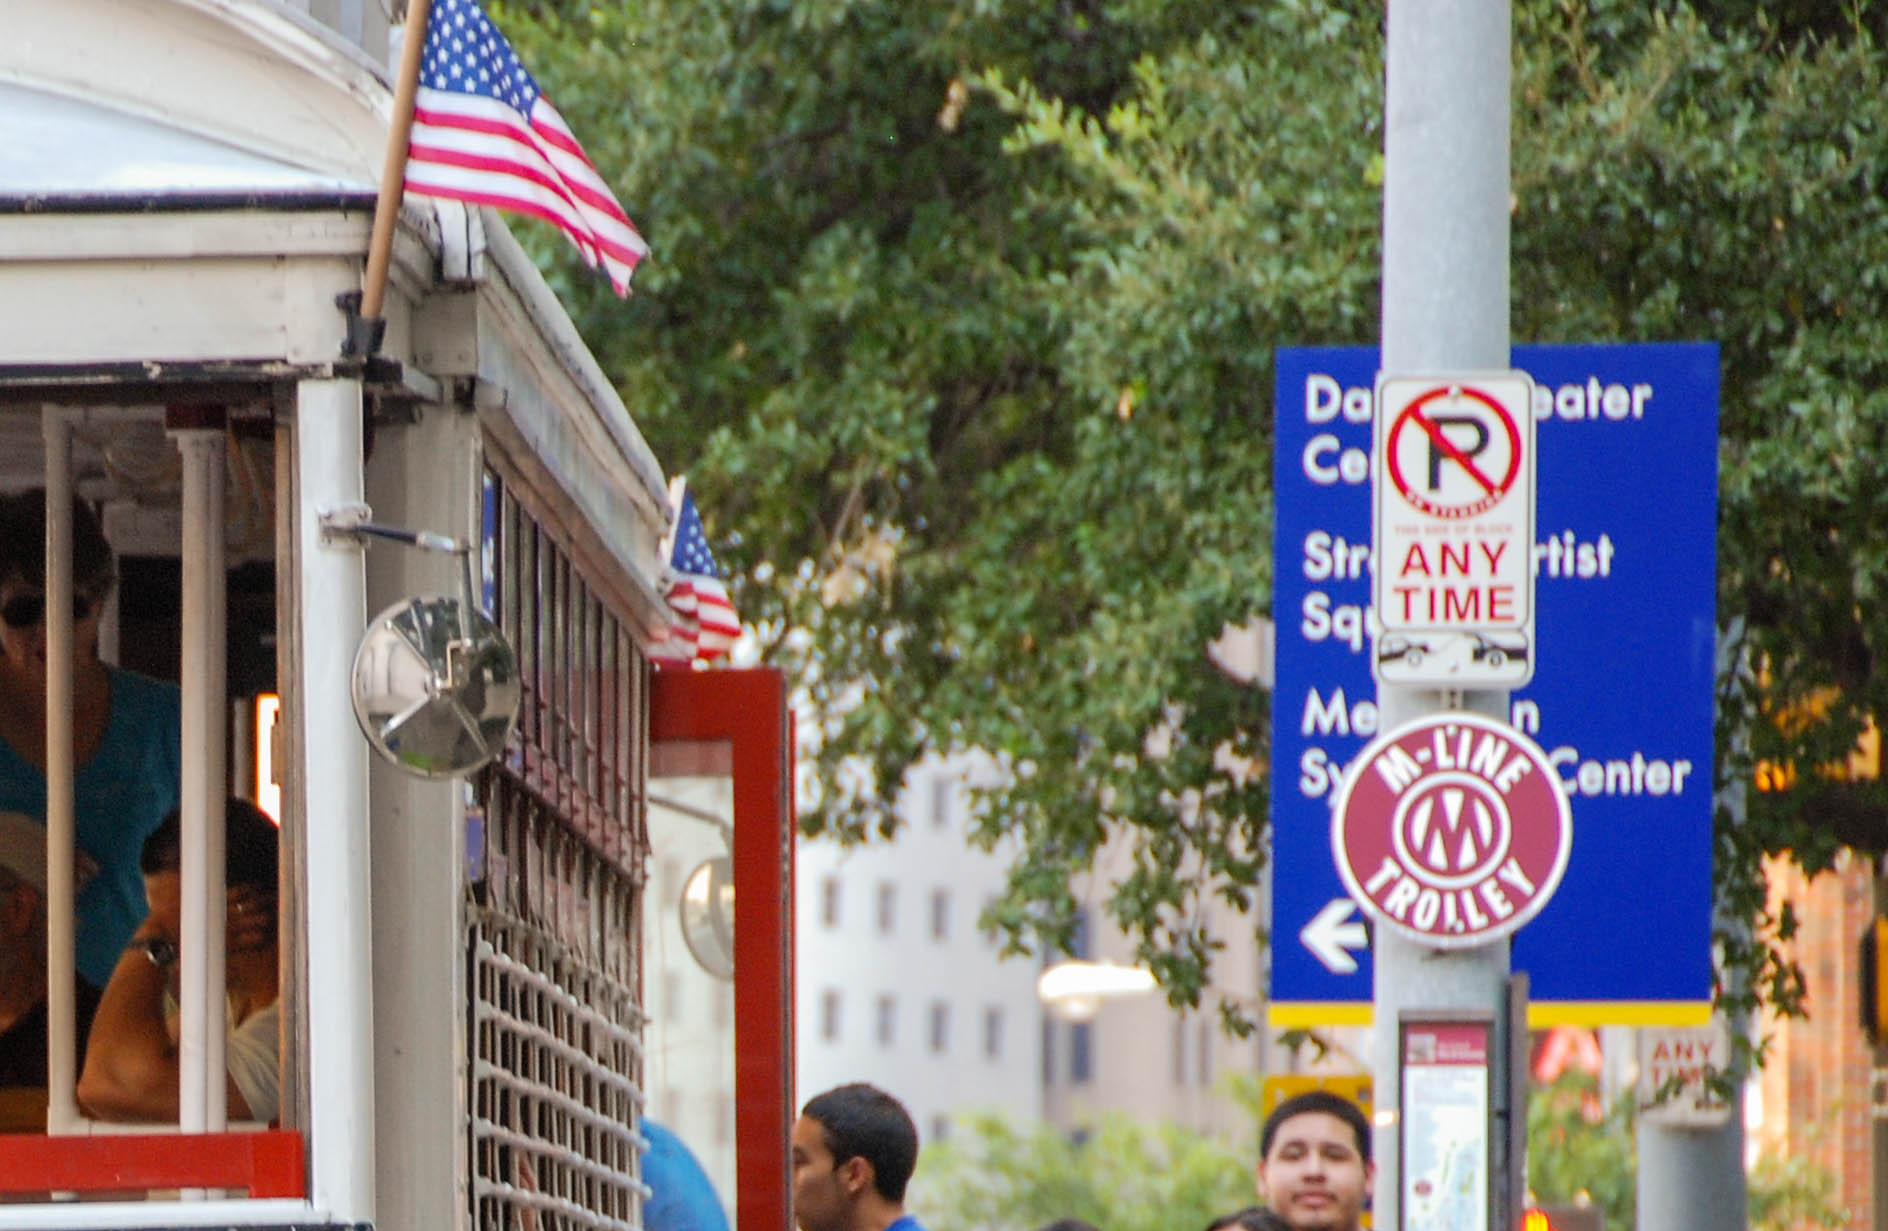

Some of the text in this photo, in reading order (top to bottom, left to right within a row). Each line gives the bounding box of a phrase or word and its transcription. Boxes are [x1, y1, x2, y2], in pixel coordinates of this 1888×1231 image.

[1534, 375, 1653, 421] eater
[1400, 541, 1508, 578] ANY
[1534, 529, 1614, 578] rtist
[1393, 585, 1516, 622] TIME
[1375, 727, 1533, 795] M-LINE
[1549, 746, 1692, 796] Center
[1364, 856, 1537, 932] TROLLEY
[1652, 1040, 1713, 1061] ANY
